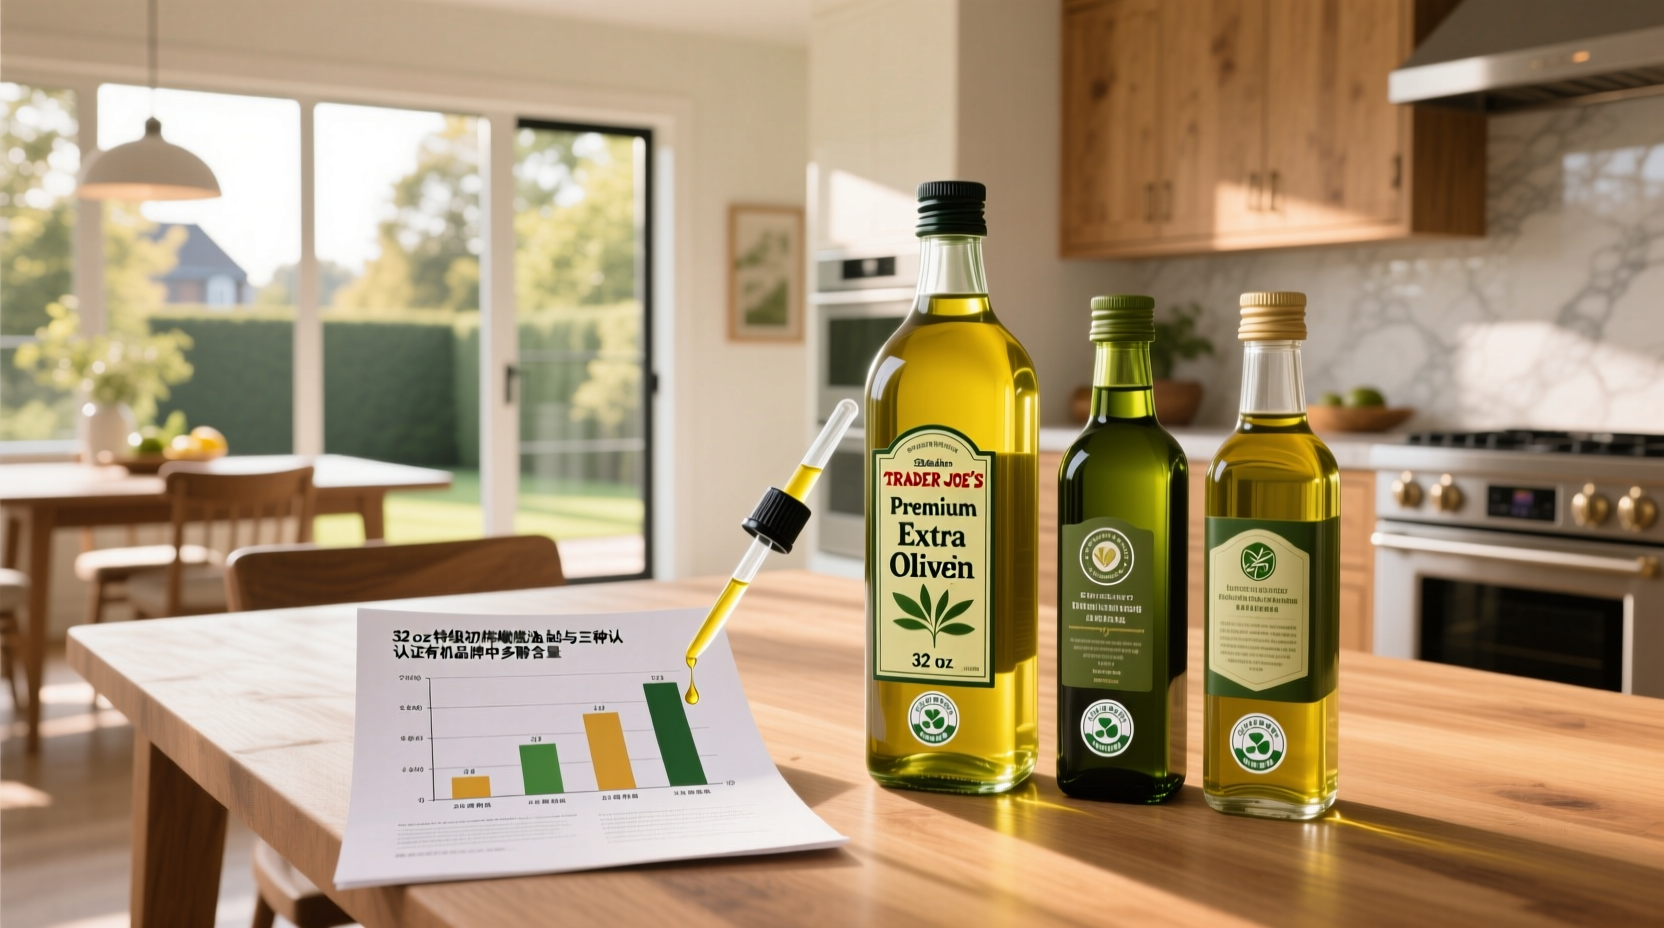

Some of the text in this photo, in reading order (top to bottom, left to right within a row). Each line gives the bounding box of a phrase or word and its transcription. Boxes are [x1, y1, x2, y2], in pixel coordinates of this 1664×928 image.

[883, 470, 984, 488] TRADER JOE'S
[890, 496, 977, 517] Premium
[898, 521, 966, 548] Extra
[392, 629, 410, 643] 32
[911, 652, 931, 668] 32
[935, 657, 954, 669] oz
